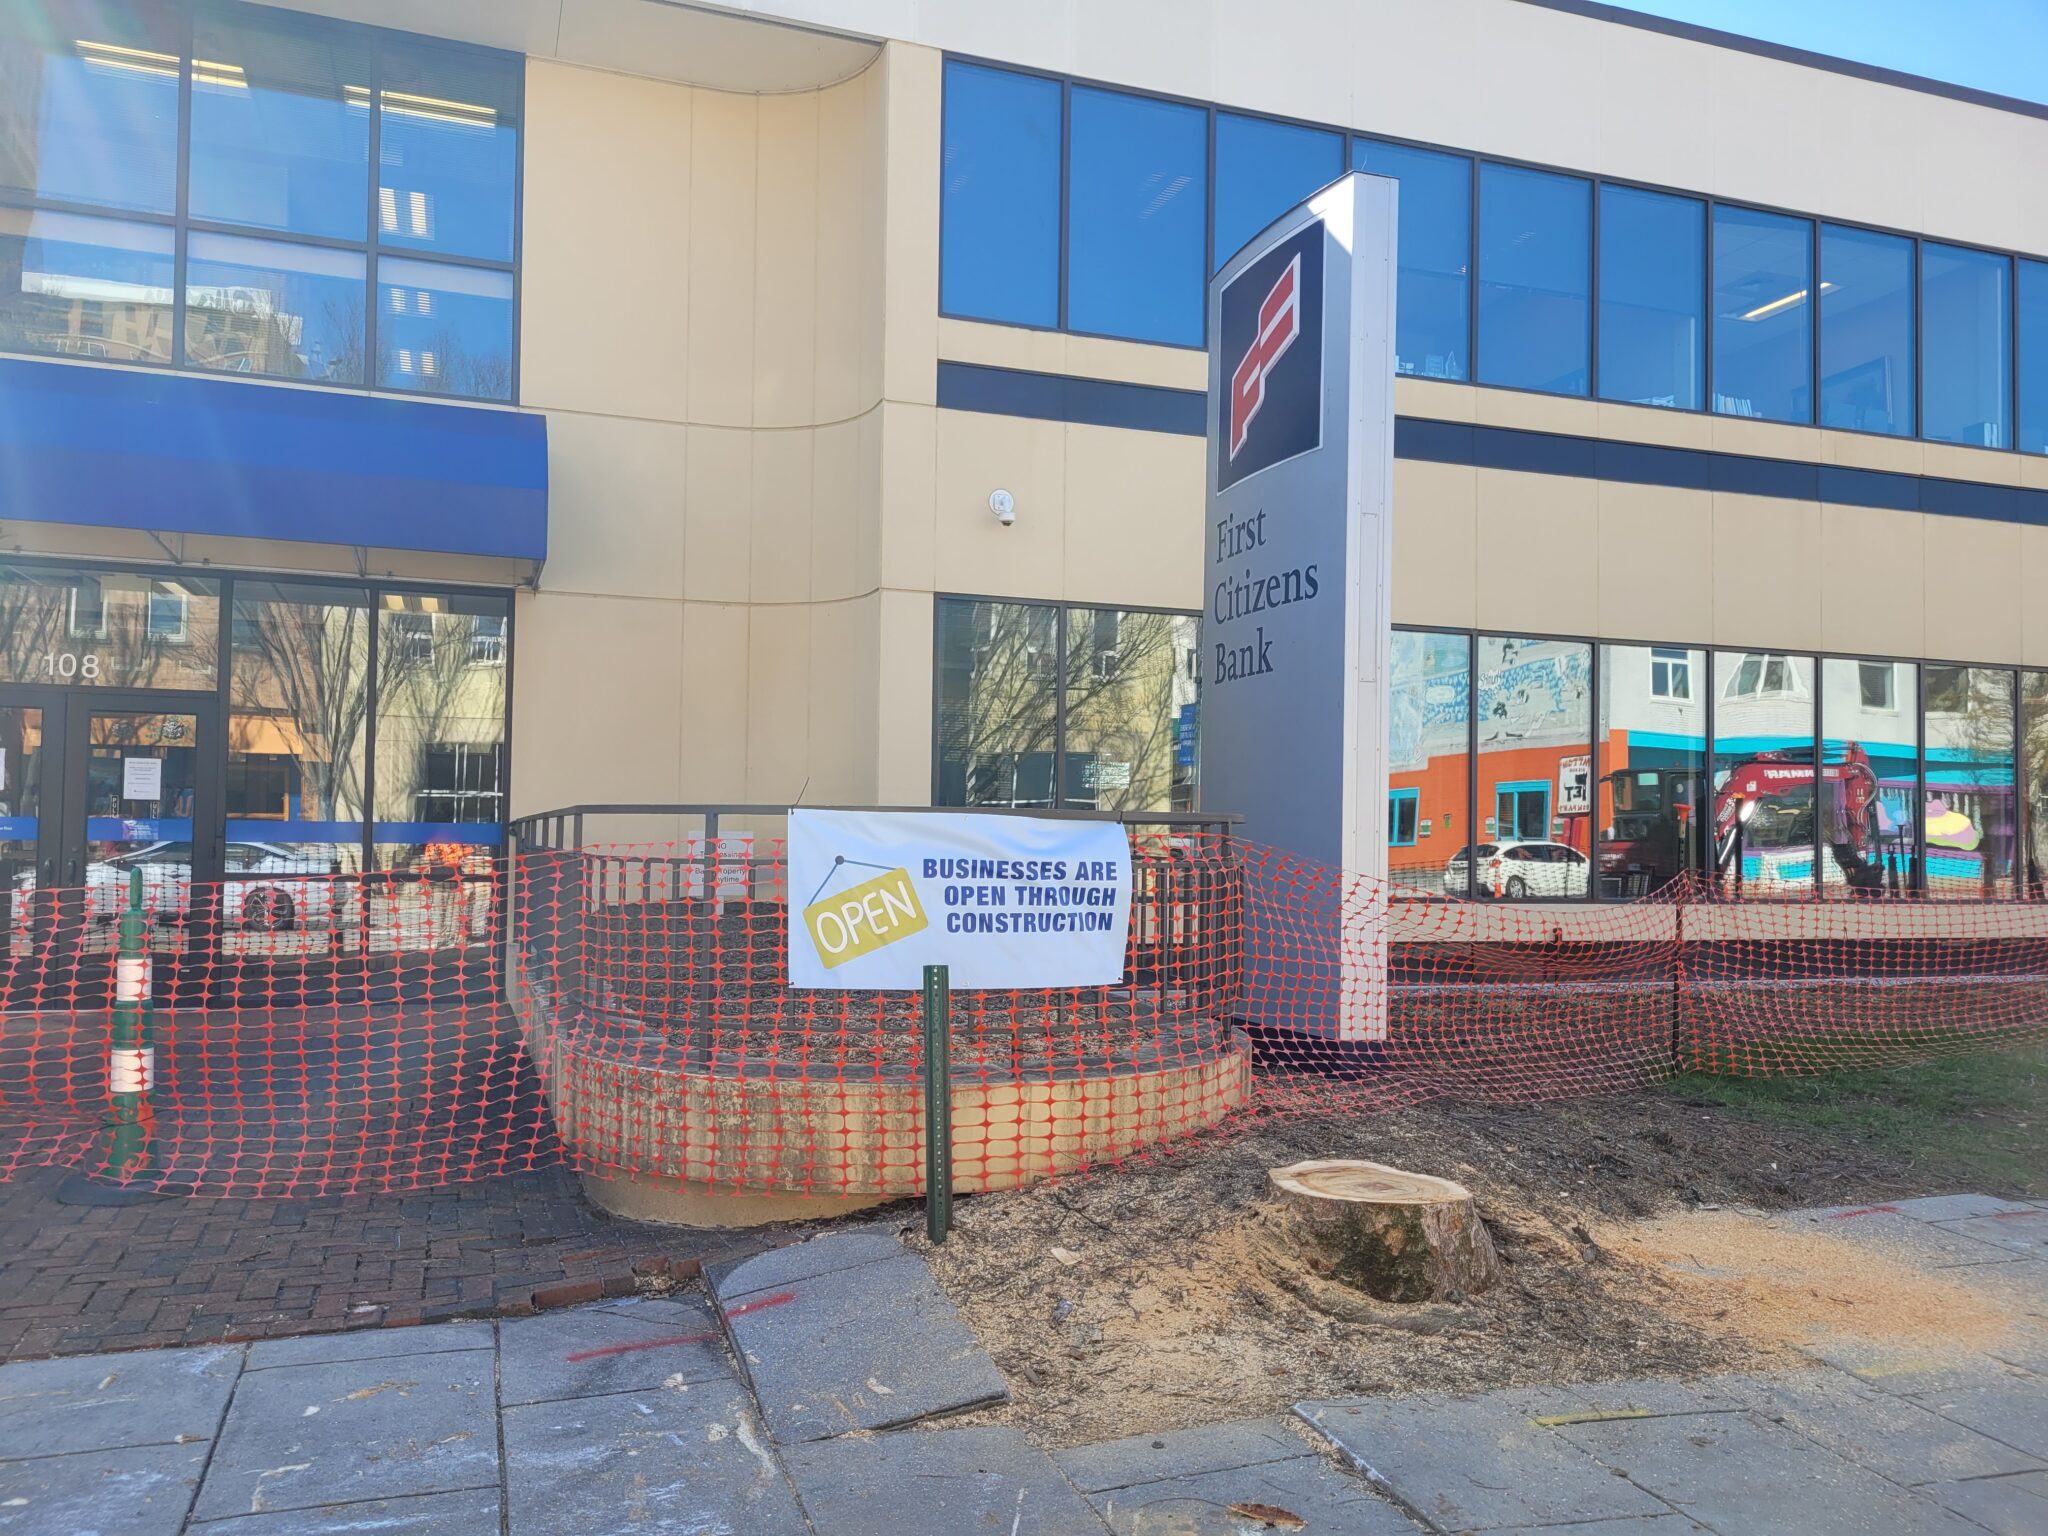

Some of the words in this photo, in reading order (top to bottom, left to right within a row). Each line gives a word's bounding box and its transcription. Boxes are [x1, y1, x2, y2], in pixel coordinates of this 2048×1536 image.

[1216, 508, 1267, 564] First
[1214, 564, 1319, 625] Citizens
[43, 652, 100, 679] 108
[1214, 627, 1274, 685] Bank
[923, 859, 1067, 881] BUSINESSES
[1075, 861, 1118, 882] ARE
[815, 880, 917, 954] OPEN
[944, 886, 1007, 907] OPEN
[1015, 886, 1117, 907] THROUGH
[946, 911, 1114, 933] CONSTRUCTION
